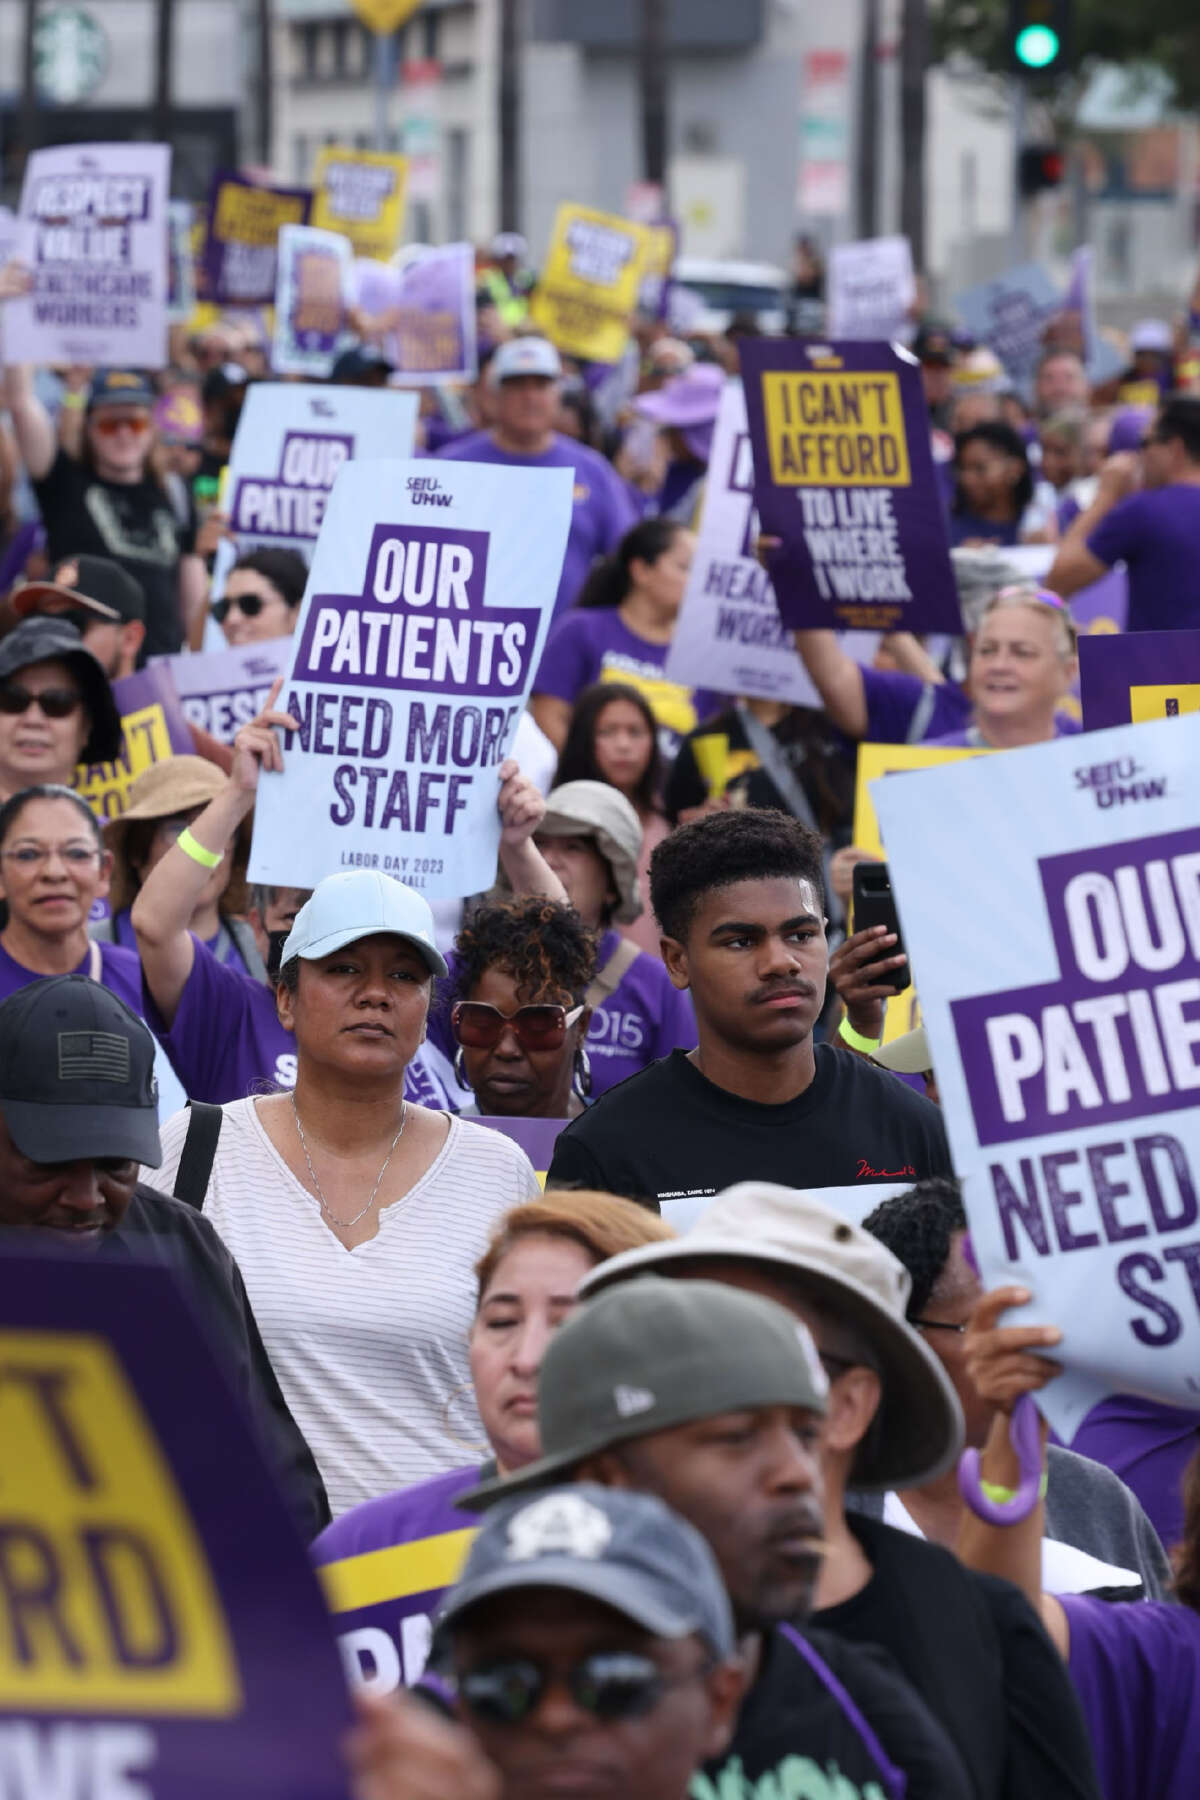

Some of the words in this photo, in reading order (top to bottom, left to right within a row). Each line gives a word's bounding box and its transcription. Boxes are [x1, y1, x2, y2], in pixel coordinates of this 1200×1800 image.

[781, 382, 791, 423] I
[798, 382, 891, 426] CAN'T
[781, 434, 900, 477] AFFORD
[411, 492, 453, 508] UHW
[797, 488, 836, 527] TO
[836, 488, 899, 527] LIVE
[803, 528, 904, 564] WHERE
[372, 537, 475, 610] OUR
[813, 565, 832, 600] I
[827, 566, 914, 601] WORK
[307, 607, 527, 688] PATIENTS
[284, 690, 394, 760] NEED
[329, 763, 474, 836] STAFF
[1095, 777, 1168, 810] UHW
[341, 852, 379, 868] LABOR
[383, 856, 409, 875] DAY
[413, 858, 445, 876] 2023
[587, 1006, 644, 1049] 015
[989, 1131, 1200, 1263] NEED
